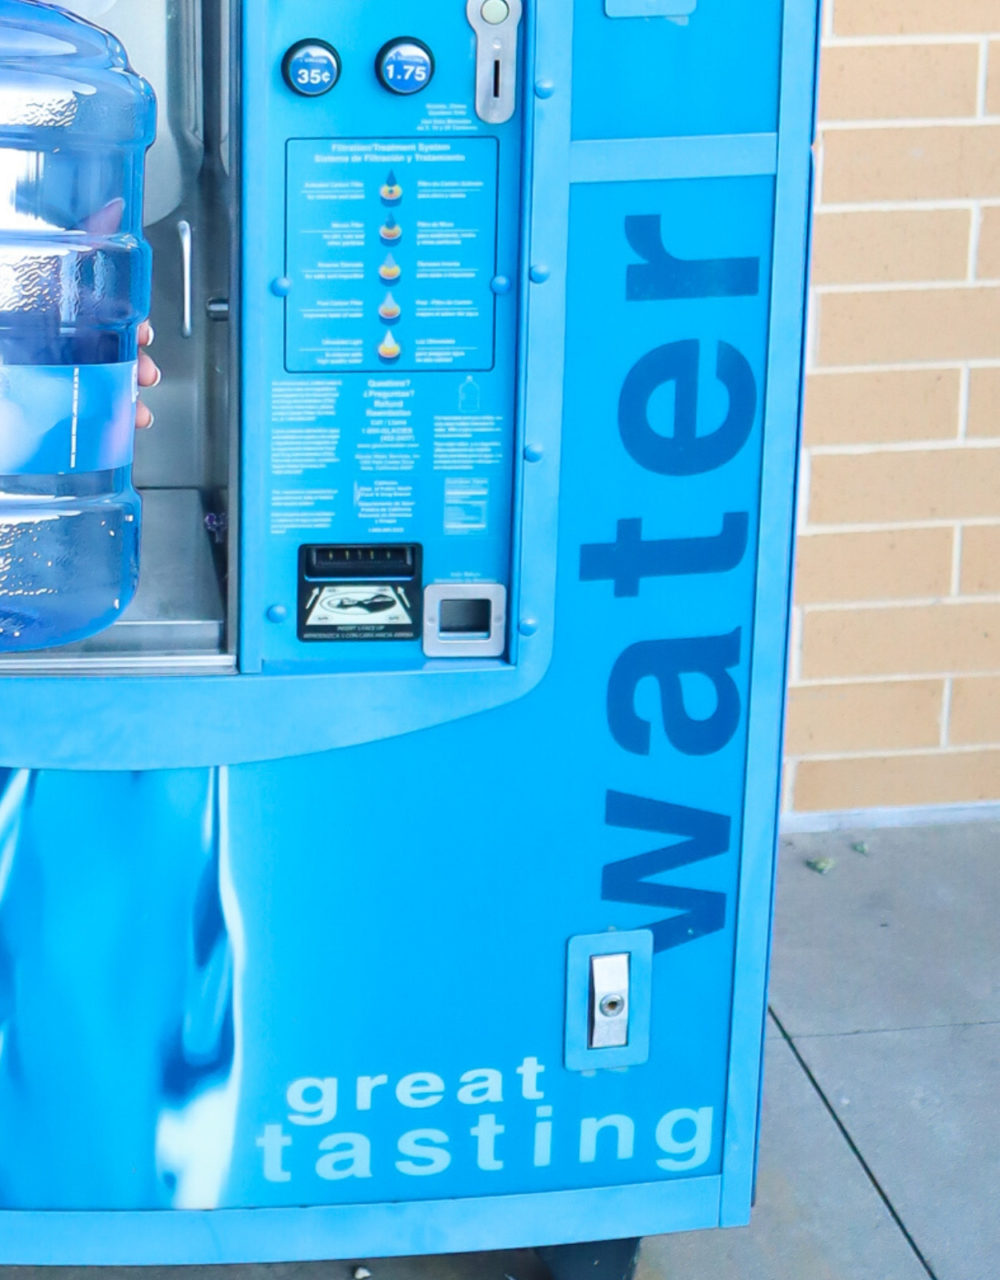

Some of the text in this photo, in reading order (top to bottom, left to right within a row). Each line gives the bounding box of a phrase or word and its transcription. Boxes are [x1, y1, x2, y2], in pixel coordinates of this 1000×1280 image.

[297, 68, 331, 85] 35¢
[386, 64, 426, 82] 1.75
[578, 213, 761, 956] water
[286, 1057, 546, 1126] great
[255, 1105, 714, 1183] tasting
